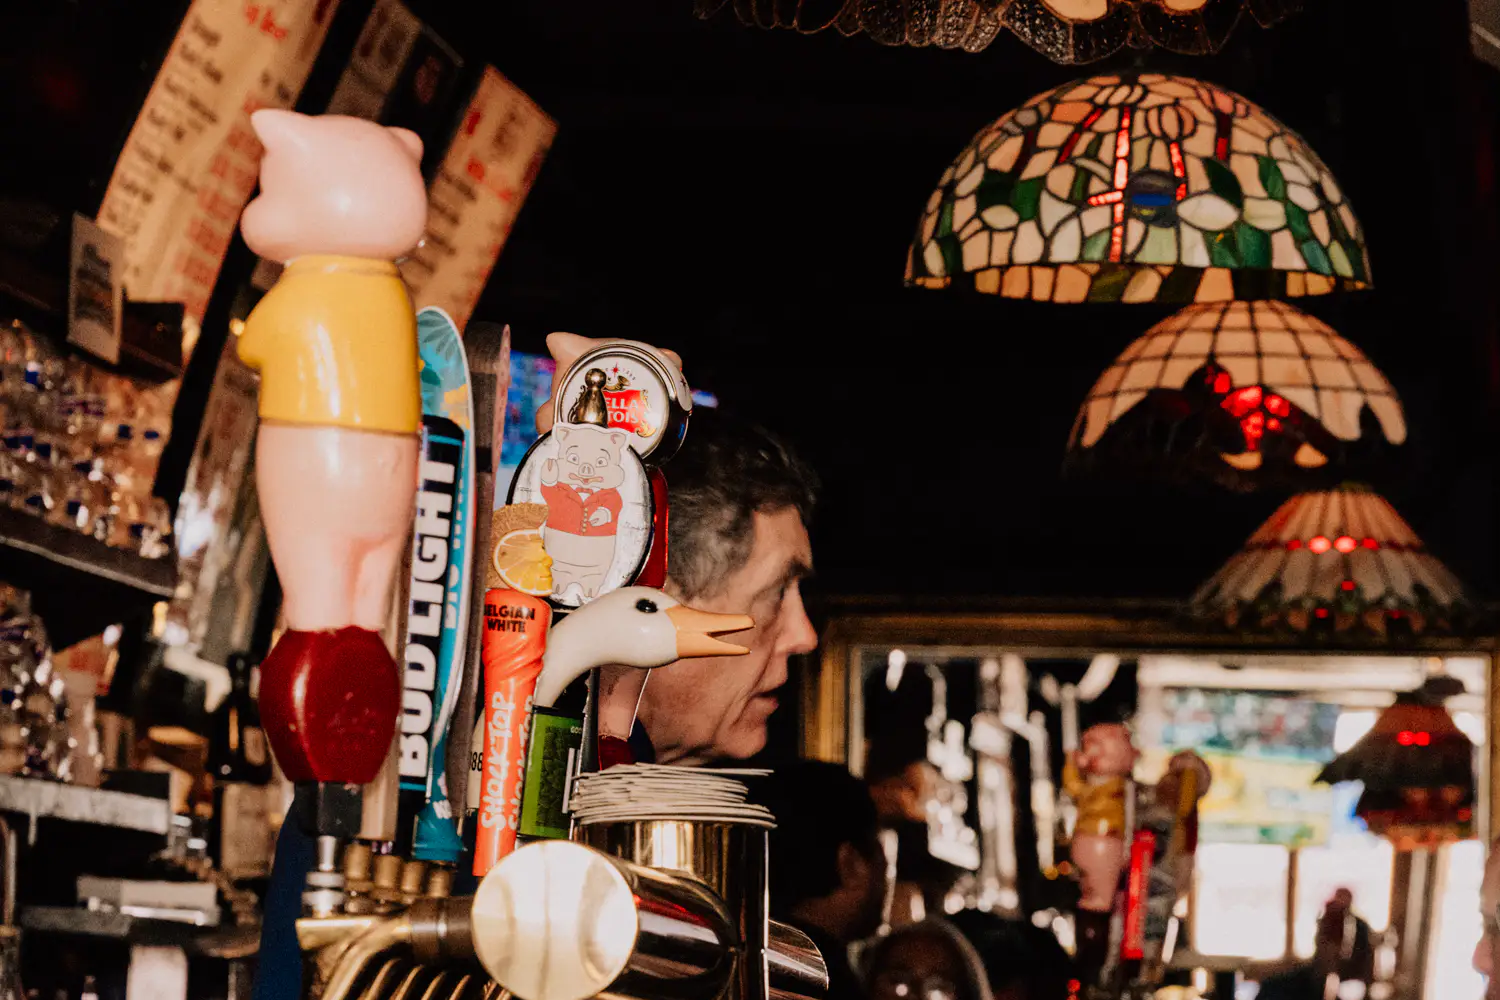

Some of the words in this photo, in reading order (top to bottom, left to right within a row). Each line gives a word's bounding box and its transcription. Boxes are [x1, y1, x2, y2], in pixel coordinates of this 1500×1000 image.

[413, 459, 456, 637] LIGHT
[487, 618, 526, 633] WHITE
[399, 645, 438, 776] BUD
